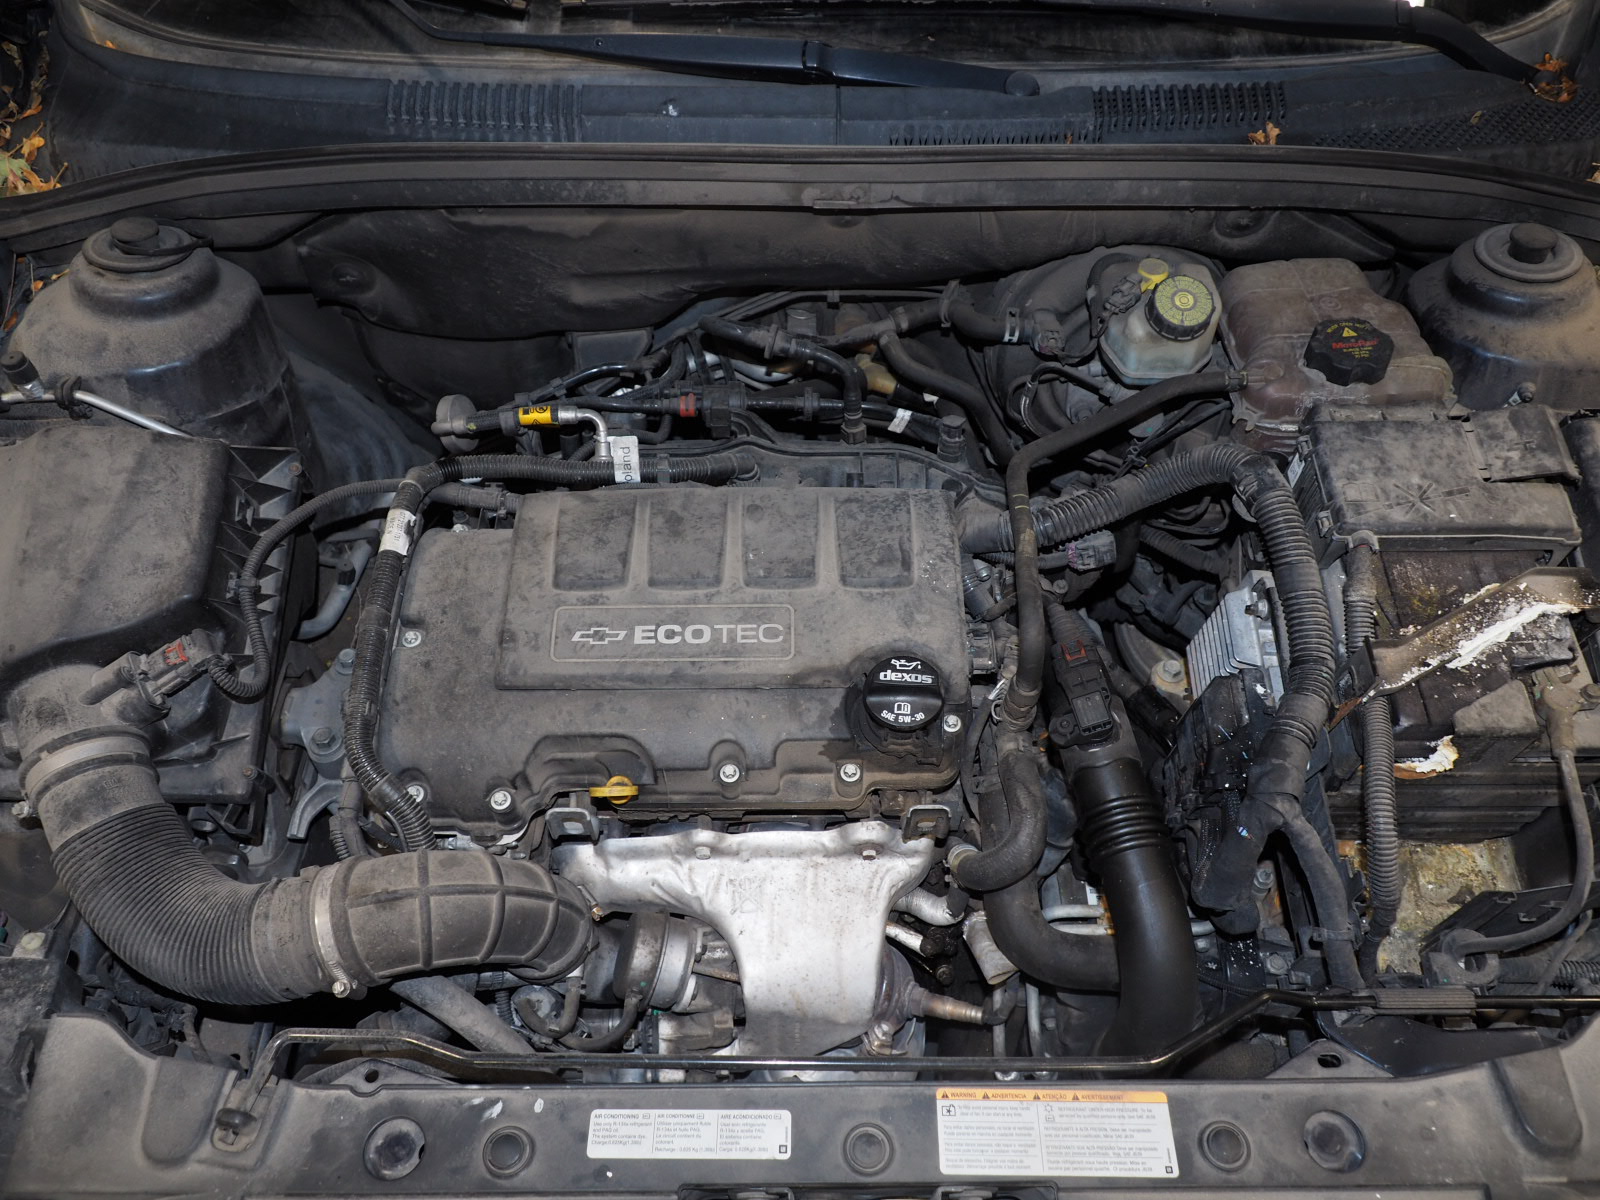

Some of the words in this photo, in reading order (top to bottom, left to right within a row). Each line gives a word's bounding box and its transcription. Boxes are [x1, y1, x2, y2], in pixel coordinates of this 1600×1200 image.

[633, 624, 784, 645] ECOTEC
[879, 669, 934, 684] dexos
[880, 710, 897, 721] SAE
[898, 712, 925, 723] 5W-30
